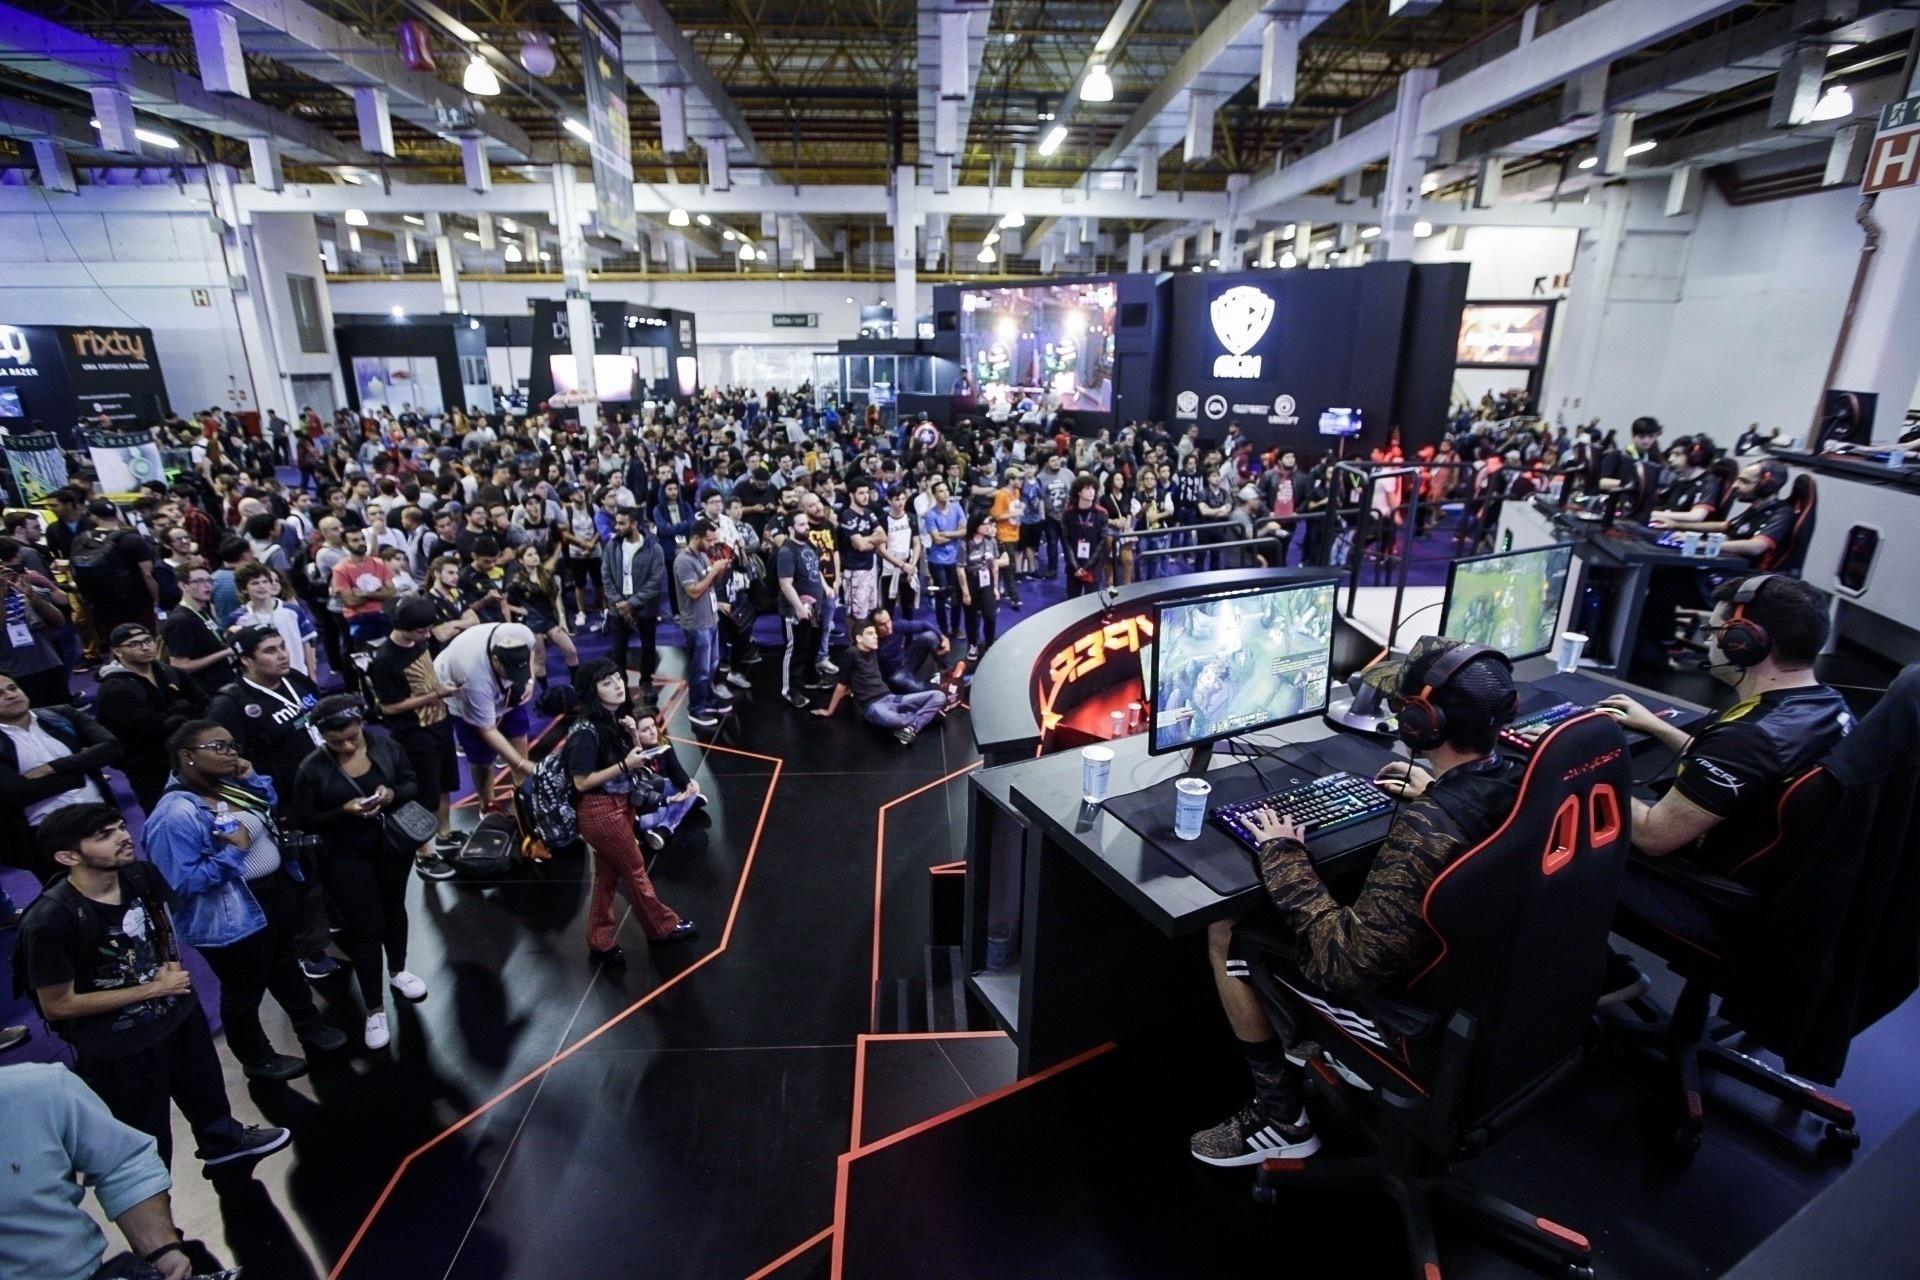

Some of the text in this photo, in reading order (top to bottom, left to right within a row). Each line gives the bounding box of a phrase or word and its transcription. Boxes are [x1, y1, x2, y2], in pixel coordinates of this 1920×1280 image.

[1870, 133, 1920, 187] H
[73, 330, 147, 361] rixty
[9, 367, 39, 377] RAZER
[17, 436, 51, 448] RAZER
[107, 433, 150, 446] RAZER
